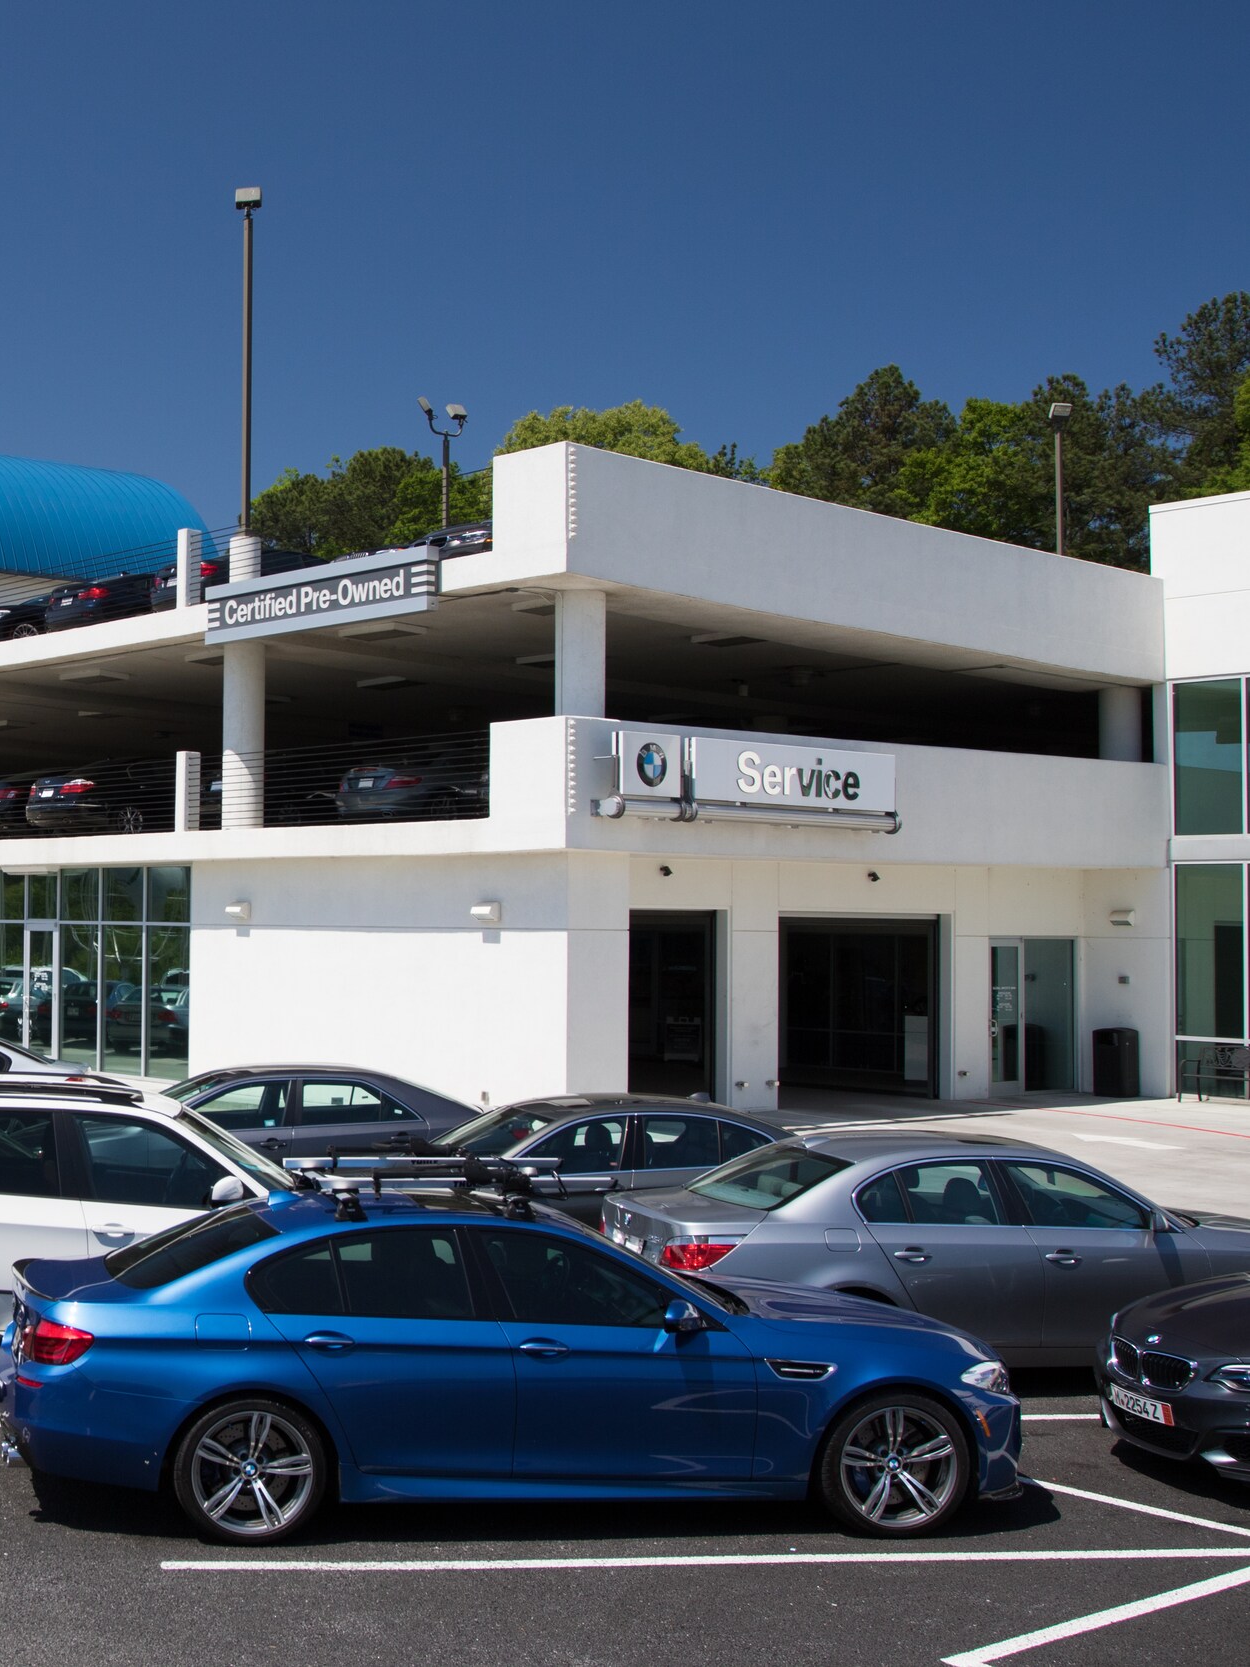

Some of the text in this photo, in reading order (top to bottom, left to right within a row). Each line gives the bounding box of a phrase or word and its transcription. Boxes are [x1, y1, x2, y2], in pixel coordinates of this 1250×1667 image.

[225, 569, 404, 625] Certified Pre-Owned
[736, 750, 860, 801] Service
